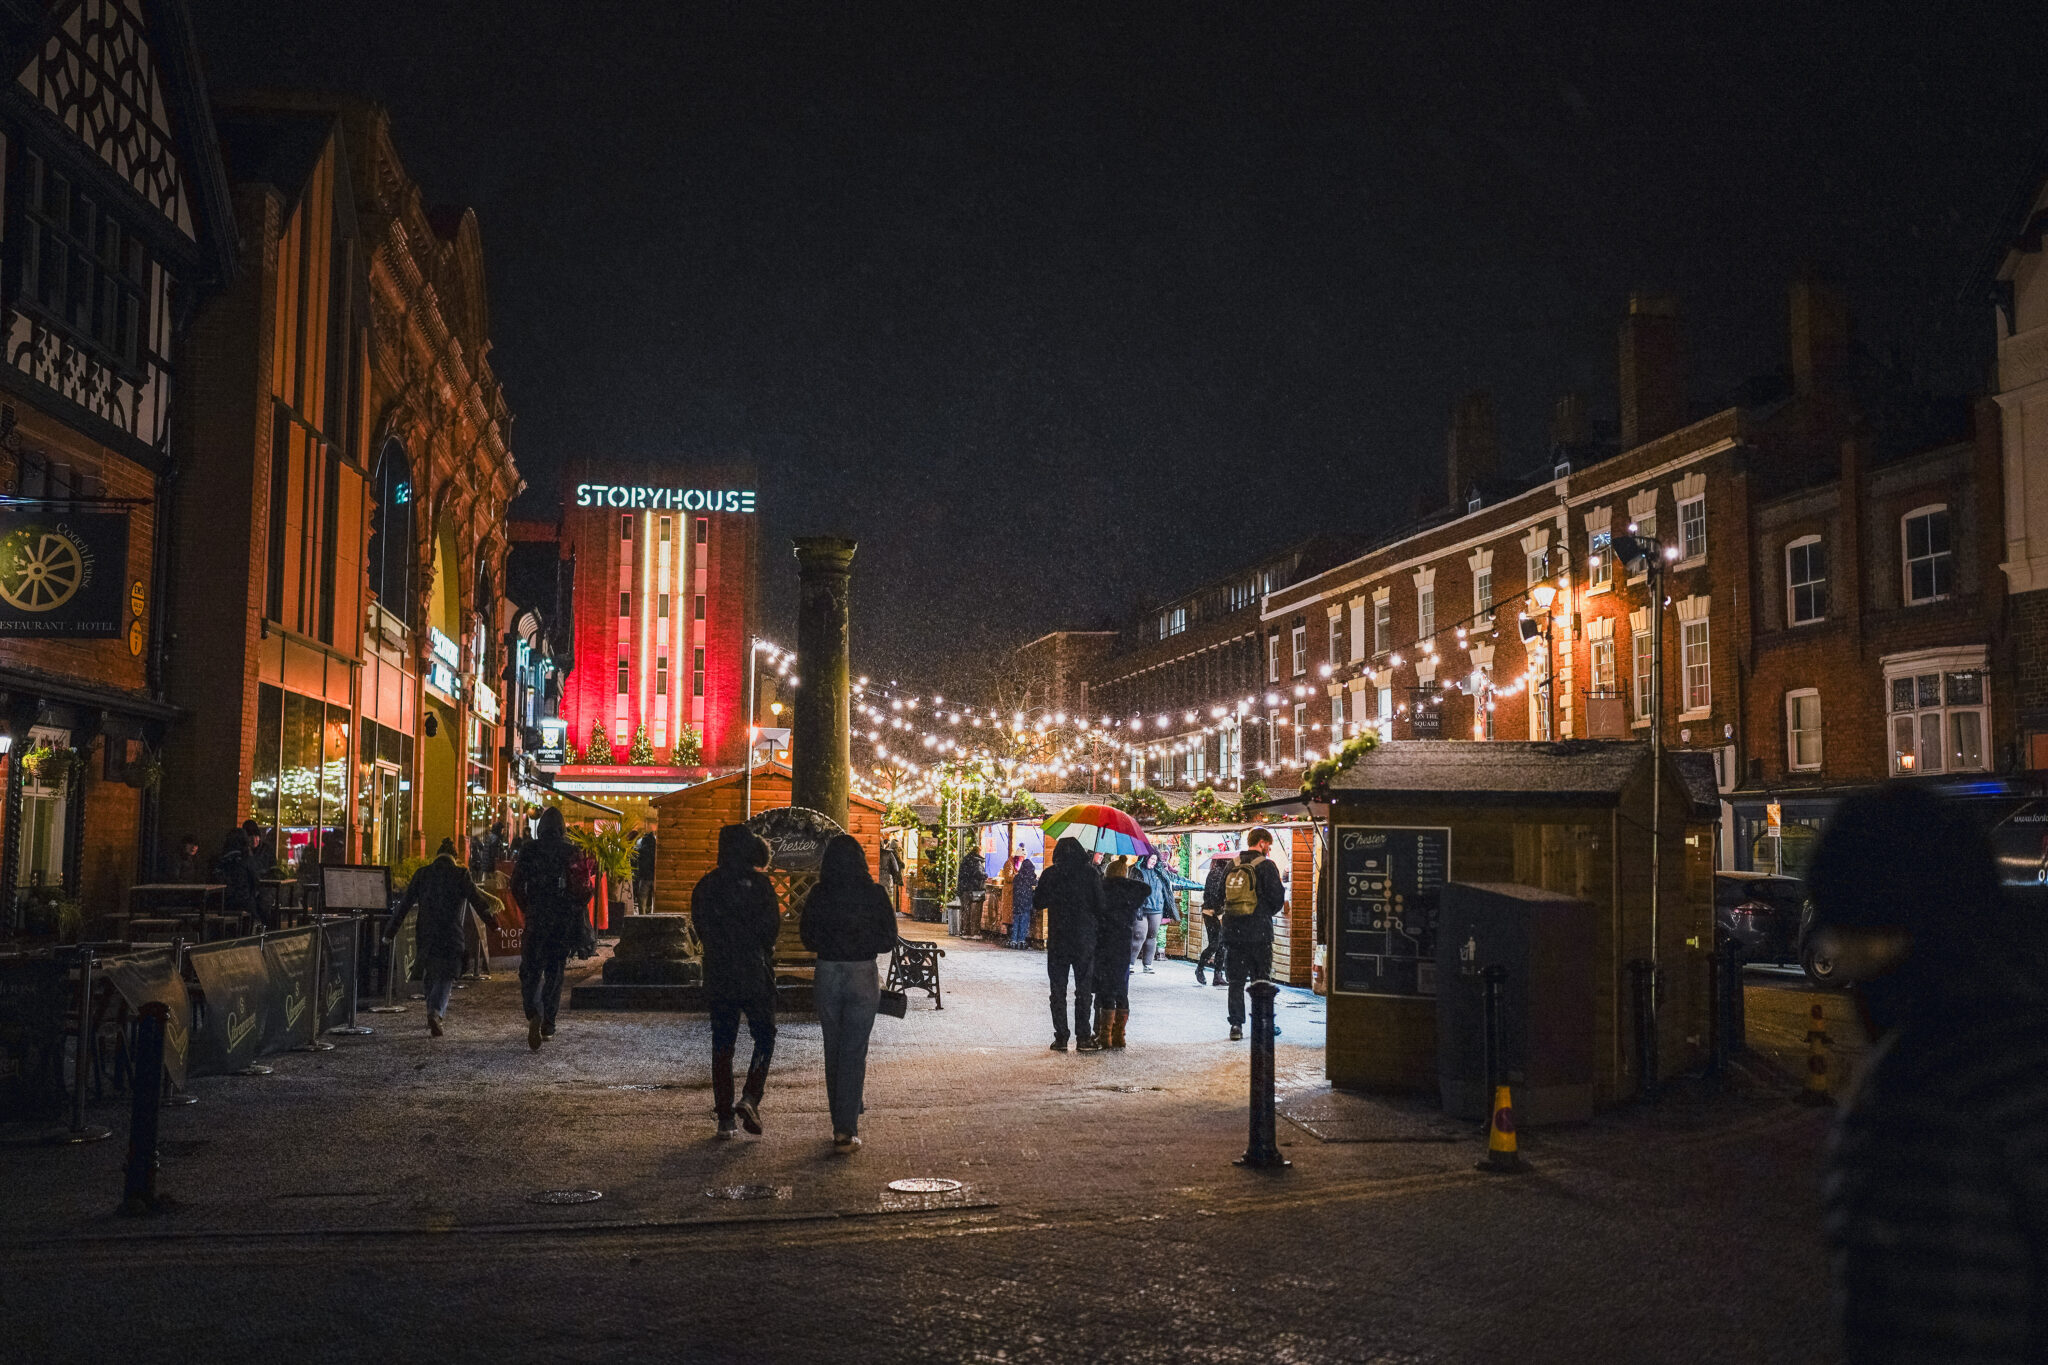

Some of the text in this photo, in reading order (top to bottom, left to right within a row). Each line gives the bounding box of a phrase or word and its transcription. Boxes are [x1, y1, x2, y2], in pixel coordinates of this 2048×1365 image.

[577, 484, 755, 513] STORYHOUSE
[56, 522, 88, 554] Coach
[0, 620, 116, 631] ESTAURANT HOTEL
[1342, 832, 1387, 850] Chester
[501, 928, 524, 938] NOR
